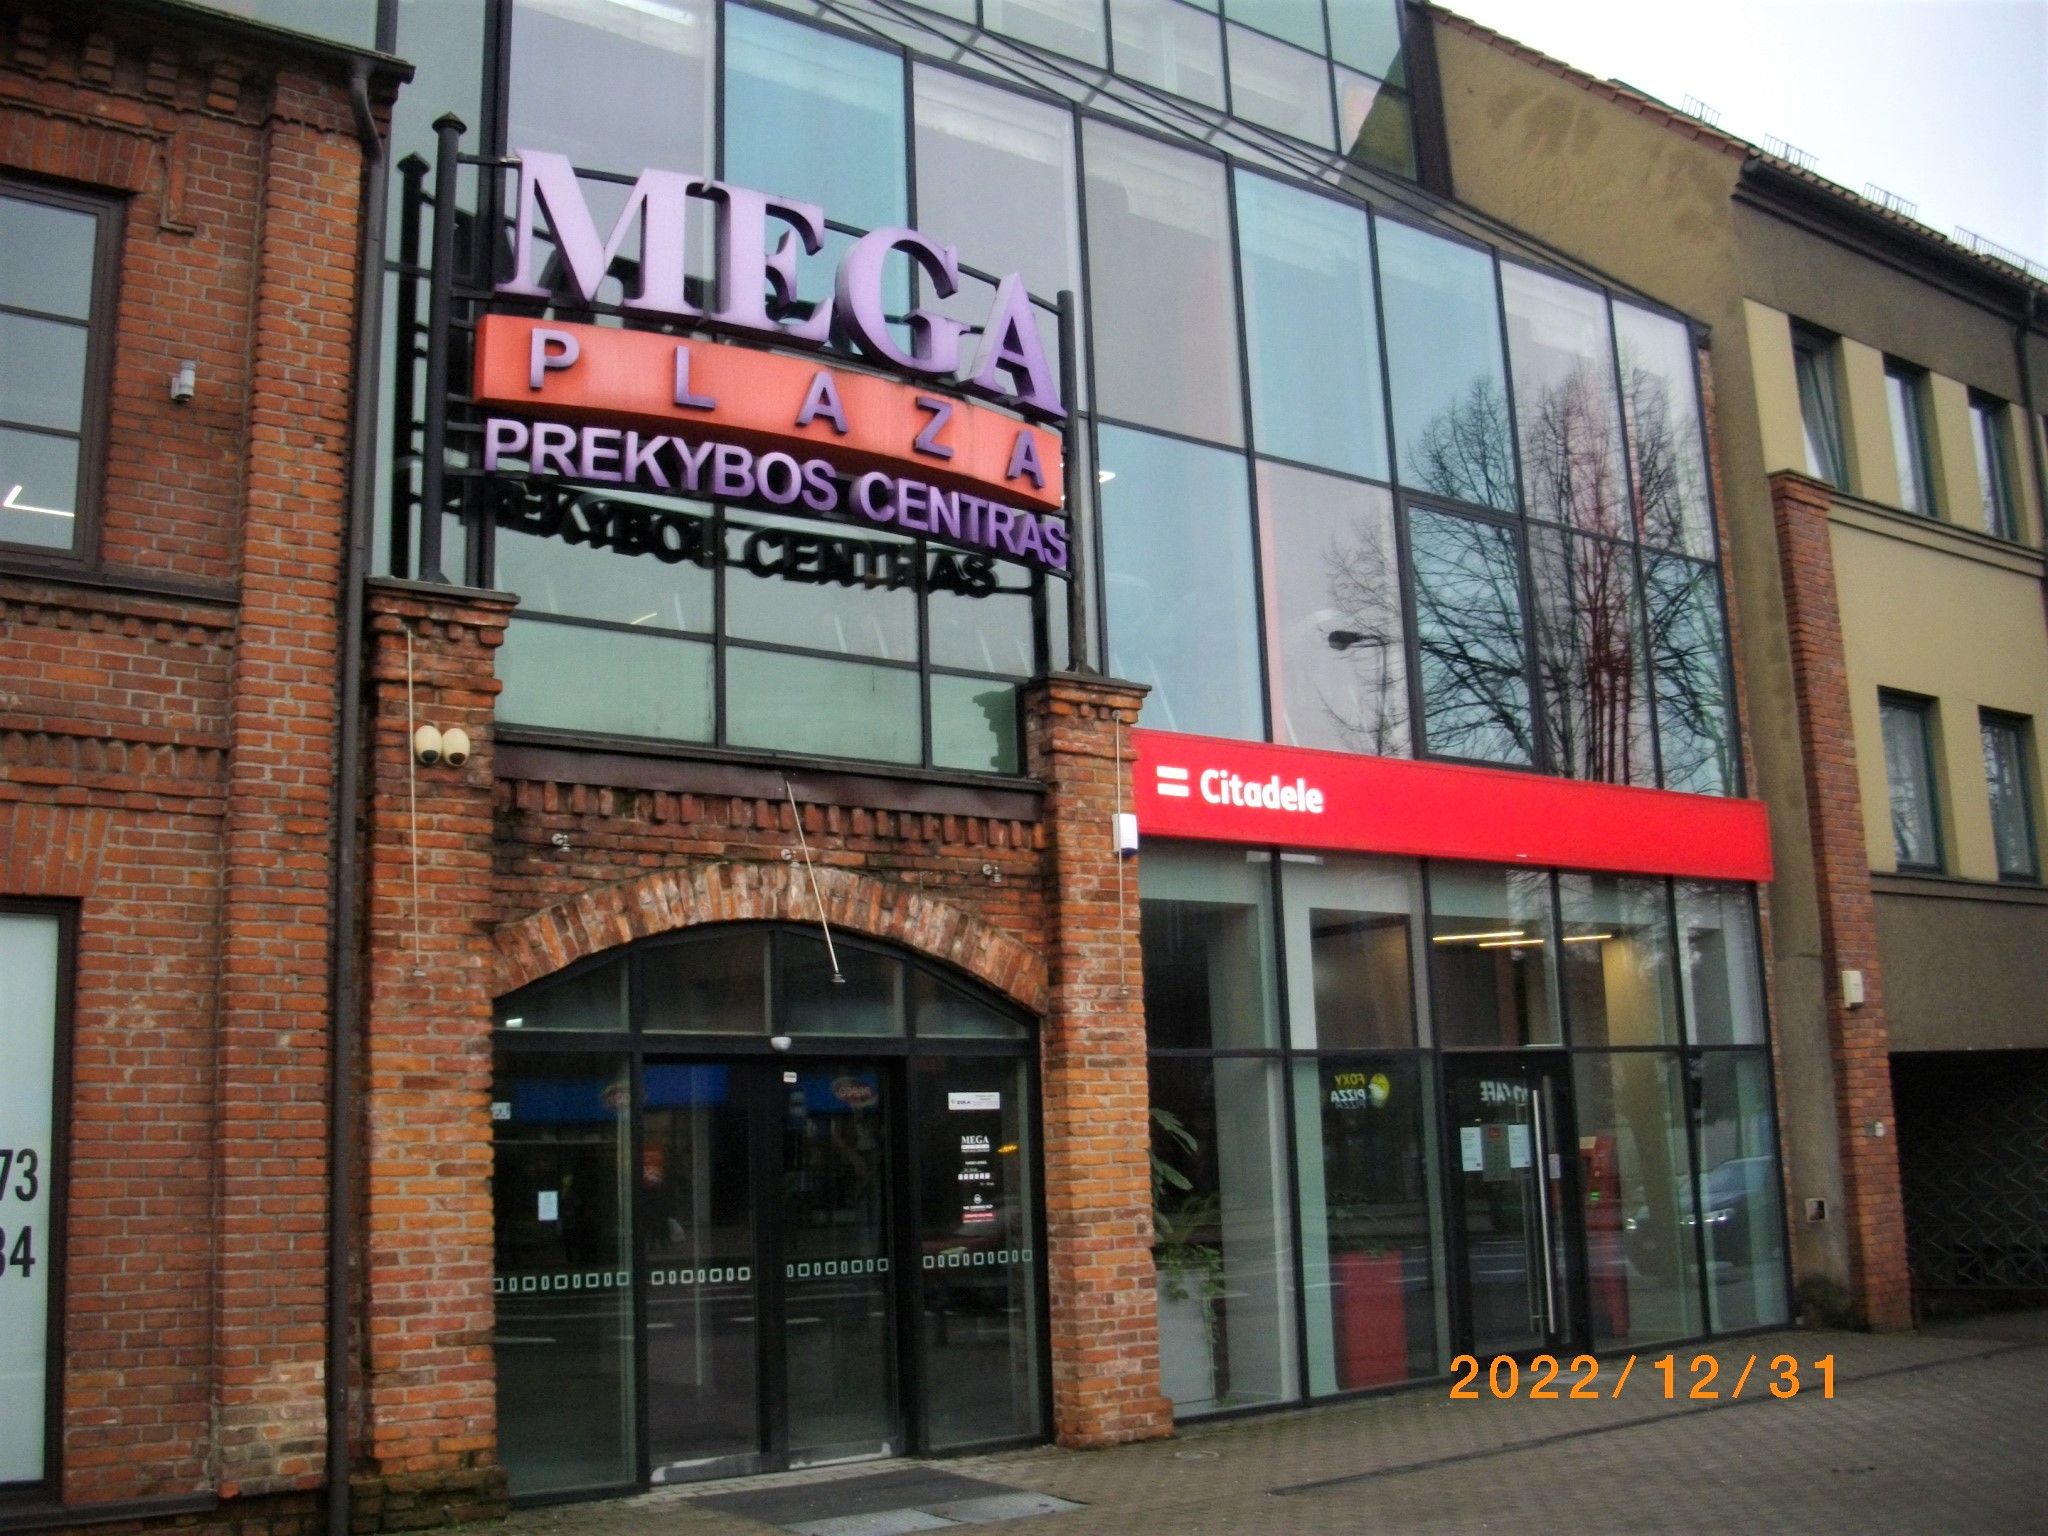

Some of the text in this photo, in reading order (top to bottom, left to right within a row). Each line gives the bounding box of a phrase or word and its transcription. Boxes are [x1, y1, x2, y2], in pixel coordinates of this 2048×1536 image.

[495, 148, 1067, 422] MEGA
[530, 327, 1045, 488] PLAZA
[484, 418, 1068, 570] PREKYBOS CENTRAS
[1200, 769, 1324, 814] Citadele
[961, 1135, 989, 1144] MEGA
[0, 1225, 36, 1278] 4
